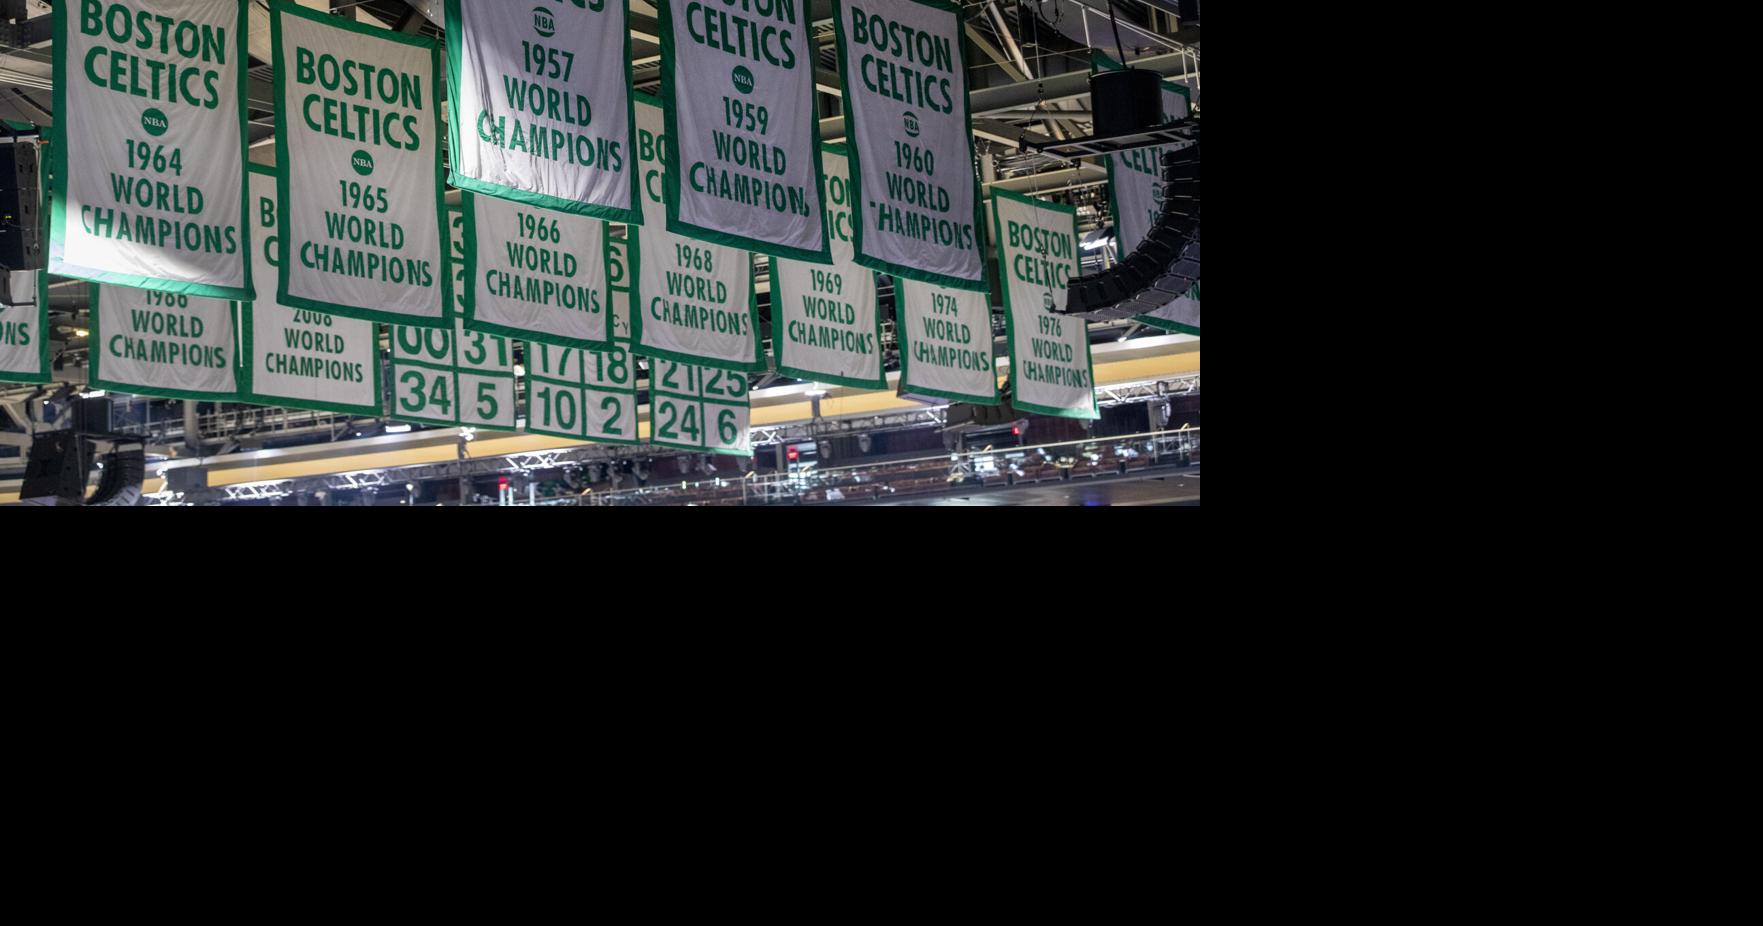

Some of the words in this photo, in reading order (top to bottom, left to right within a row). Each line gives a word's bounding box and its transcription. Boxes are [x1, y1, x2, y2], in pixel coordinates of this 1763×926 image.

[80, 0, 225, 64] BOSTON
[534, 14, 555, 31] NBA
[686, 2, 795, 69] CELTICS
[852, 6, 953, 74] BOSTON
[84, 46, 219, 109] CELTICS
[296, 46, 422, 110] BOSTON
[522, 40, 574, 82] 1957
[734, 73, 752, 86] NBA
[504, 75, 592, 127] WORLD
[860, 53, 953, 115] CELTICS
[144, 116, 167, 128] NBA
[302, 93, 420, 151] CELTICS
[722, 96, 768, 135] 1959
[904, 118, 920, 131] NBA
[126, 139, 182, 176] 1964
[477, 110, 622, 173] CHAMPIONS
[712, 130, 786, 176] WORLD
[894, 140, 934, 176] 1960
[353, 158, 373, 169] NBA
[110, 173, 204, 215] WORLD
[340, 180, 388, 214] 1965
[886, 172, 950, 213] WORLD
[82, 204, 236, 254] CHAMPIONS
[325, 210, 404, 250] WORLD
[517, 212, 560, 244] 1966
[870, 201, 972, 250] HAMPIONS
[1008, 220, 1072, 260] BOSTON
[300, 240, 433, 288] CHAMPIONS
[506, 240, 577, 278] WORLD
[674, 243, 713, 273] 1968
[486, 269, 600, 314] CHAMPIONS
[666, 270, 727, 304] WORLD
[810, 268, 842, 296] 1969
[651, 296, 748, 336] CHAMPIONS
[802, 294, 856, 326] WORLD
[931, 292, 958, 318] 1974
[131, 310, 204, 338] WORLD
[284, 328, 344, 354] WORLD
[788, 320, 874, 356] CHAMPIONS
[922, 316, 970, 344] WORLD
[1038, 315, 1062, 338] 1976
[109, 334, 226, 368] CHAMPIONS
[398, 326, 450, 360] 00
[464, 330, 508, 366] 31
[538, 343, 572, 376] 17
[914, 340, 990, 372] CHAMPIONS
[1032, 338, 1072, 363] WORLD
[266, 352, 364, 383] CHAMPIONS
[590, 347, 628, 384] 18
[704, 367, 747, 398] 25
[1023, 360, 1088, 388] CHAMPIONS
[400, 370, 451, 415] 34
[477, 382, 498, 420] 5
[536, 386, 576, 430] 10
[601, 396, 622, 436] 2
[658, 401, 700, 442] 24
[718, 408, 738, 445] 6
